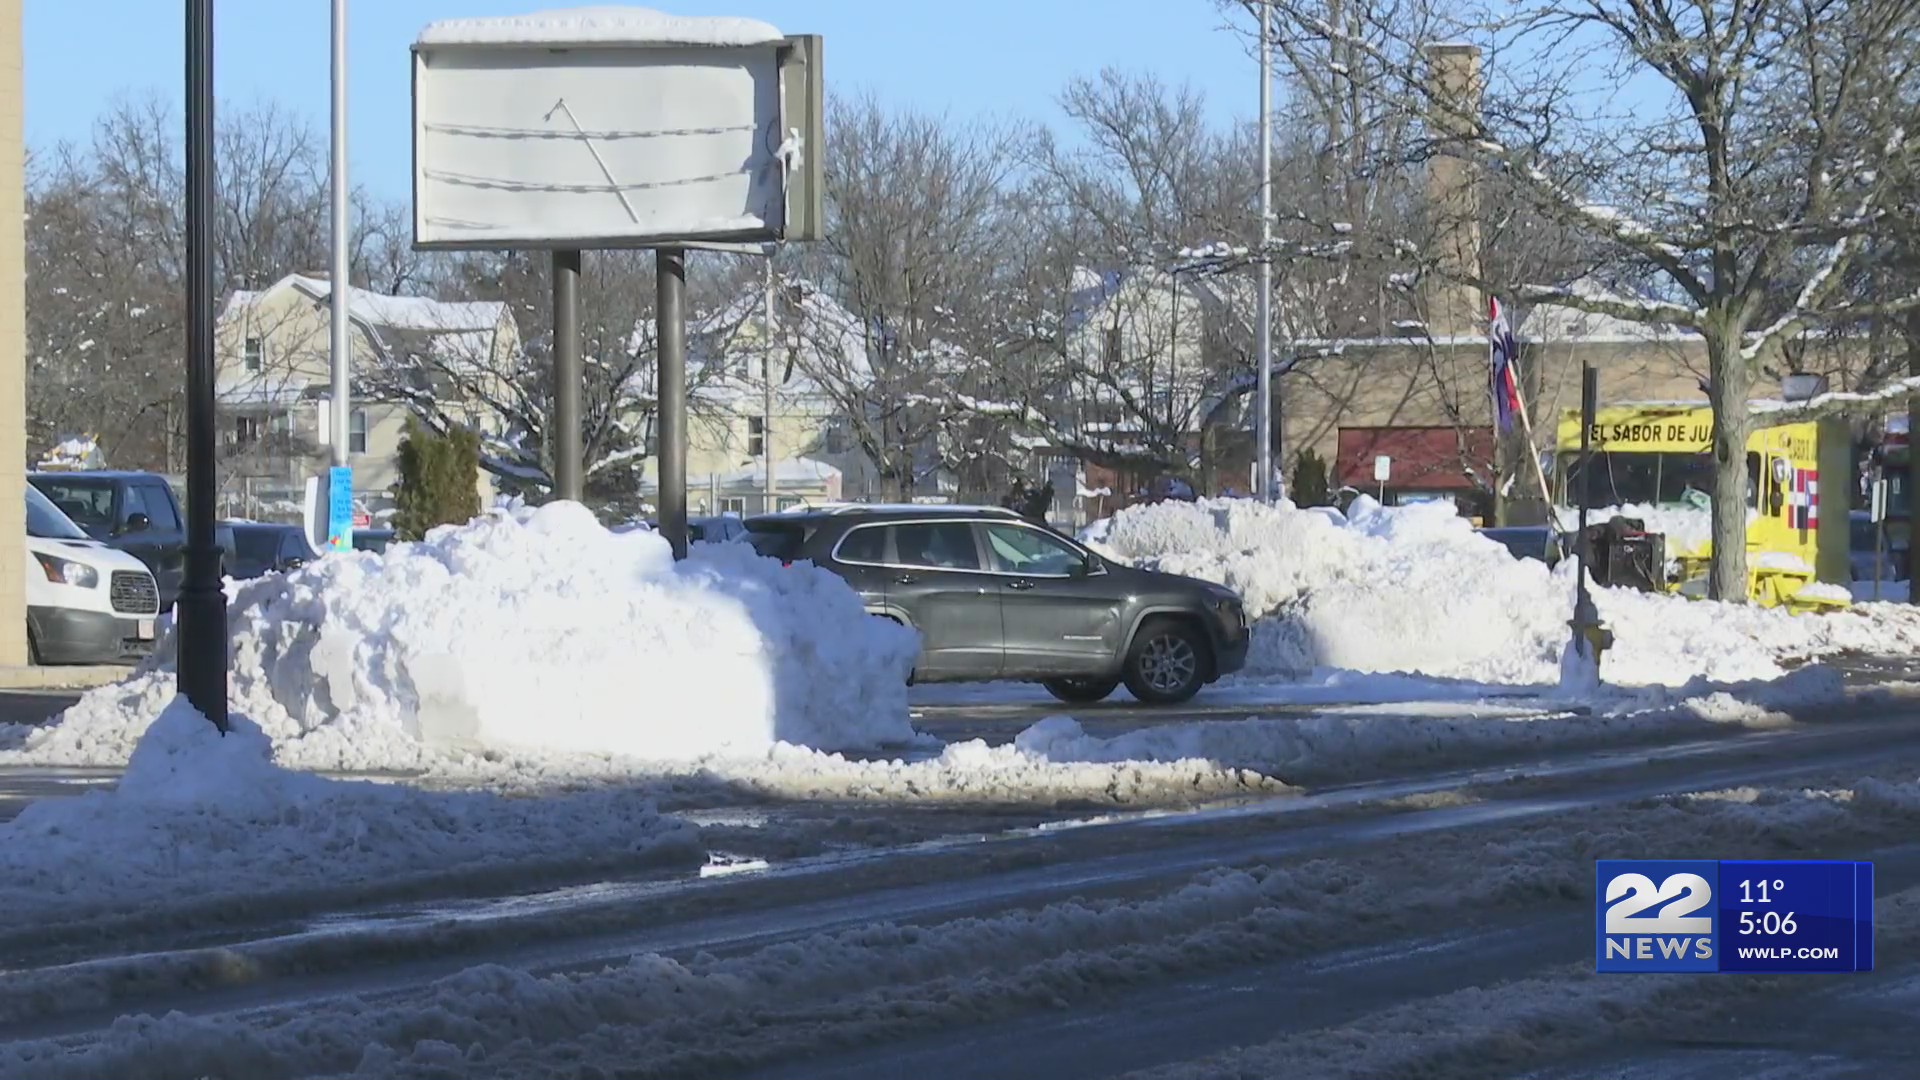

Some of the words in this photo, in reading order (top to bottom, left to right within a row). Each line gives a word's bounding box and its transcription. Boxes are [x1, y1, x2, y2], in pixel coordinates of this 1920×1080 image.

[1591, 424, 1608, 441] EL
[1613, 424, 1662, 442] SABOR
[1667, 425, 1686, 441] DE
